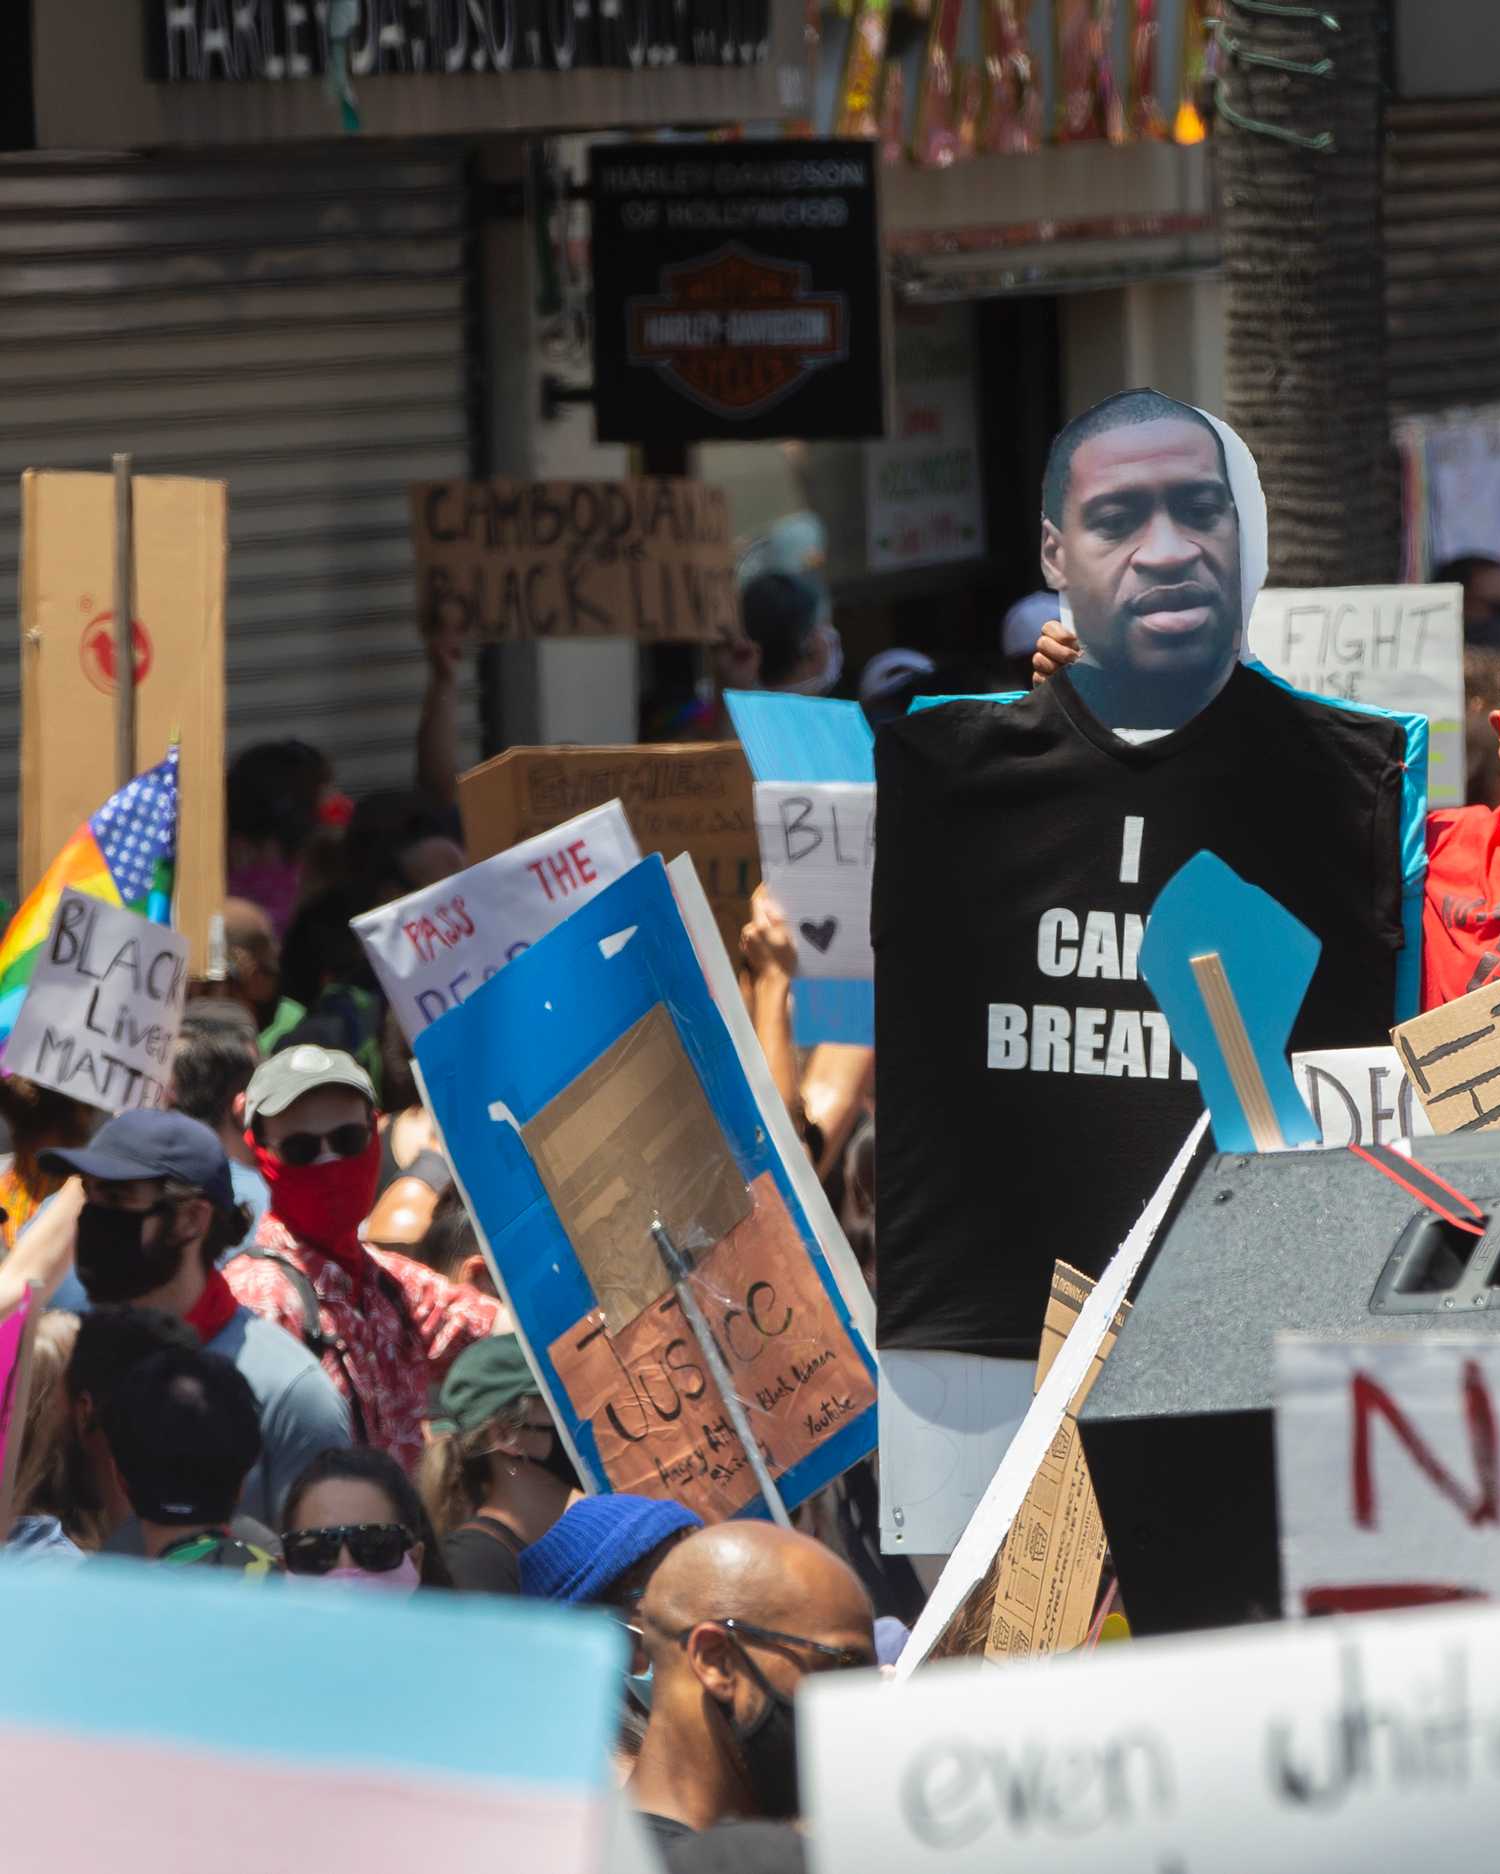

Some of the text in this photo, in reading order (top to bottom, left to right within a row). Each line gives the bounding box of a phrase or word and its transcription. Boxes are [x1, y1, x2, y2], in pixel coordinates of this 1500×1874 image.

[1281, 601, 1451, 674] FIGHT
[526, 839, 596, 902] THE
[1119, 815, 1144, 883] I
[402, 894, 474, 963] PASS
[987, 1003, 1198, 1080] BREAT
[899, 1722, 1177, 1852] even
